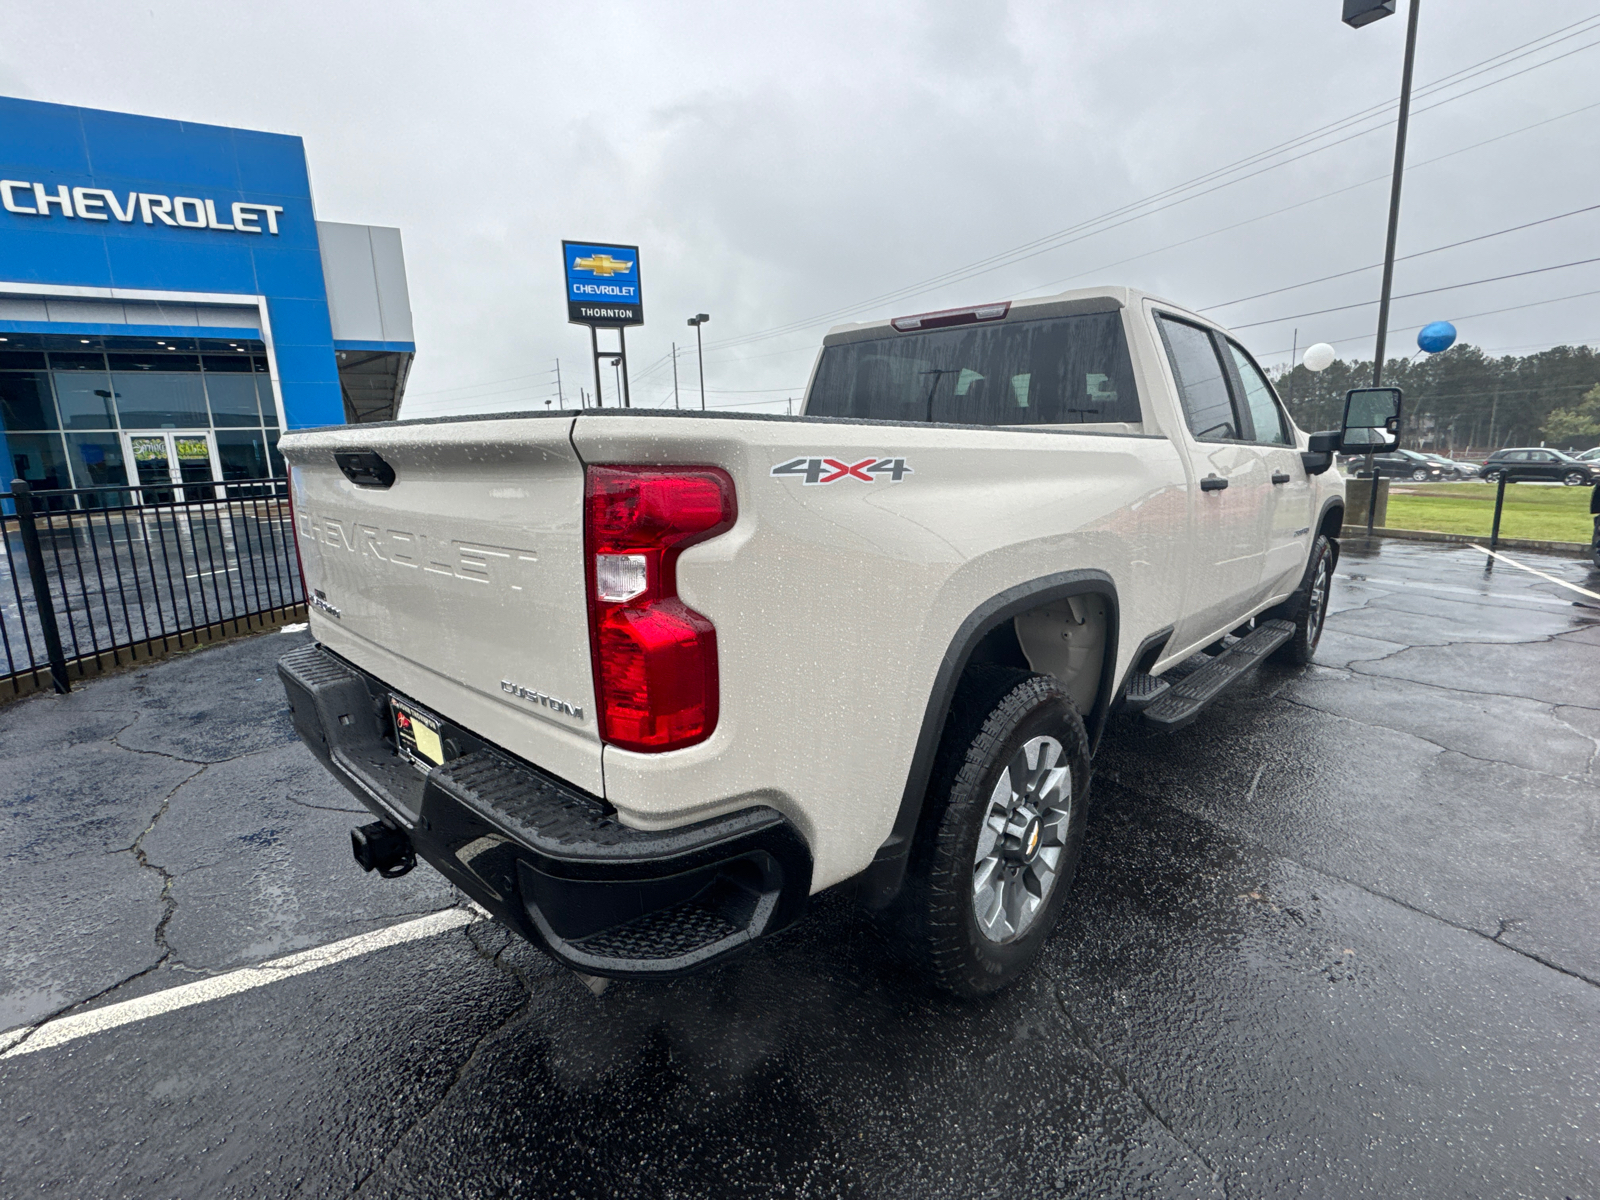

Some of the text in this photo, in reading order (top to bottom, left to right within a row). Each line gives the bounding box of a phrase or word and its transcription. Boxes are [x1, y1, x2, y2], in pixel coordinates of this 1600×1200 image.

[0, 179, 284, 235] CHEVROLET
[573, 284, 635, 296] CHEVROLET
[581, 307, 633, 318] THORNTON
[298, 510, 538, 590] CHEVROLET
[500, 679, 584, 720] CUSTOM
